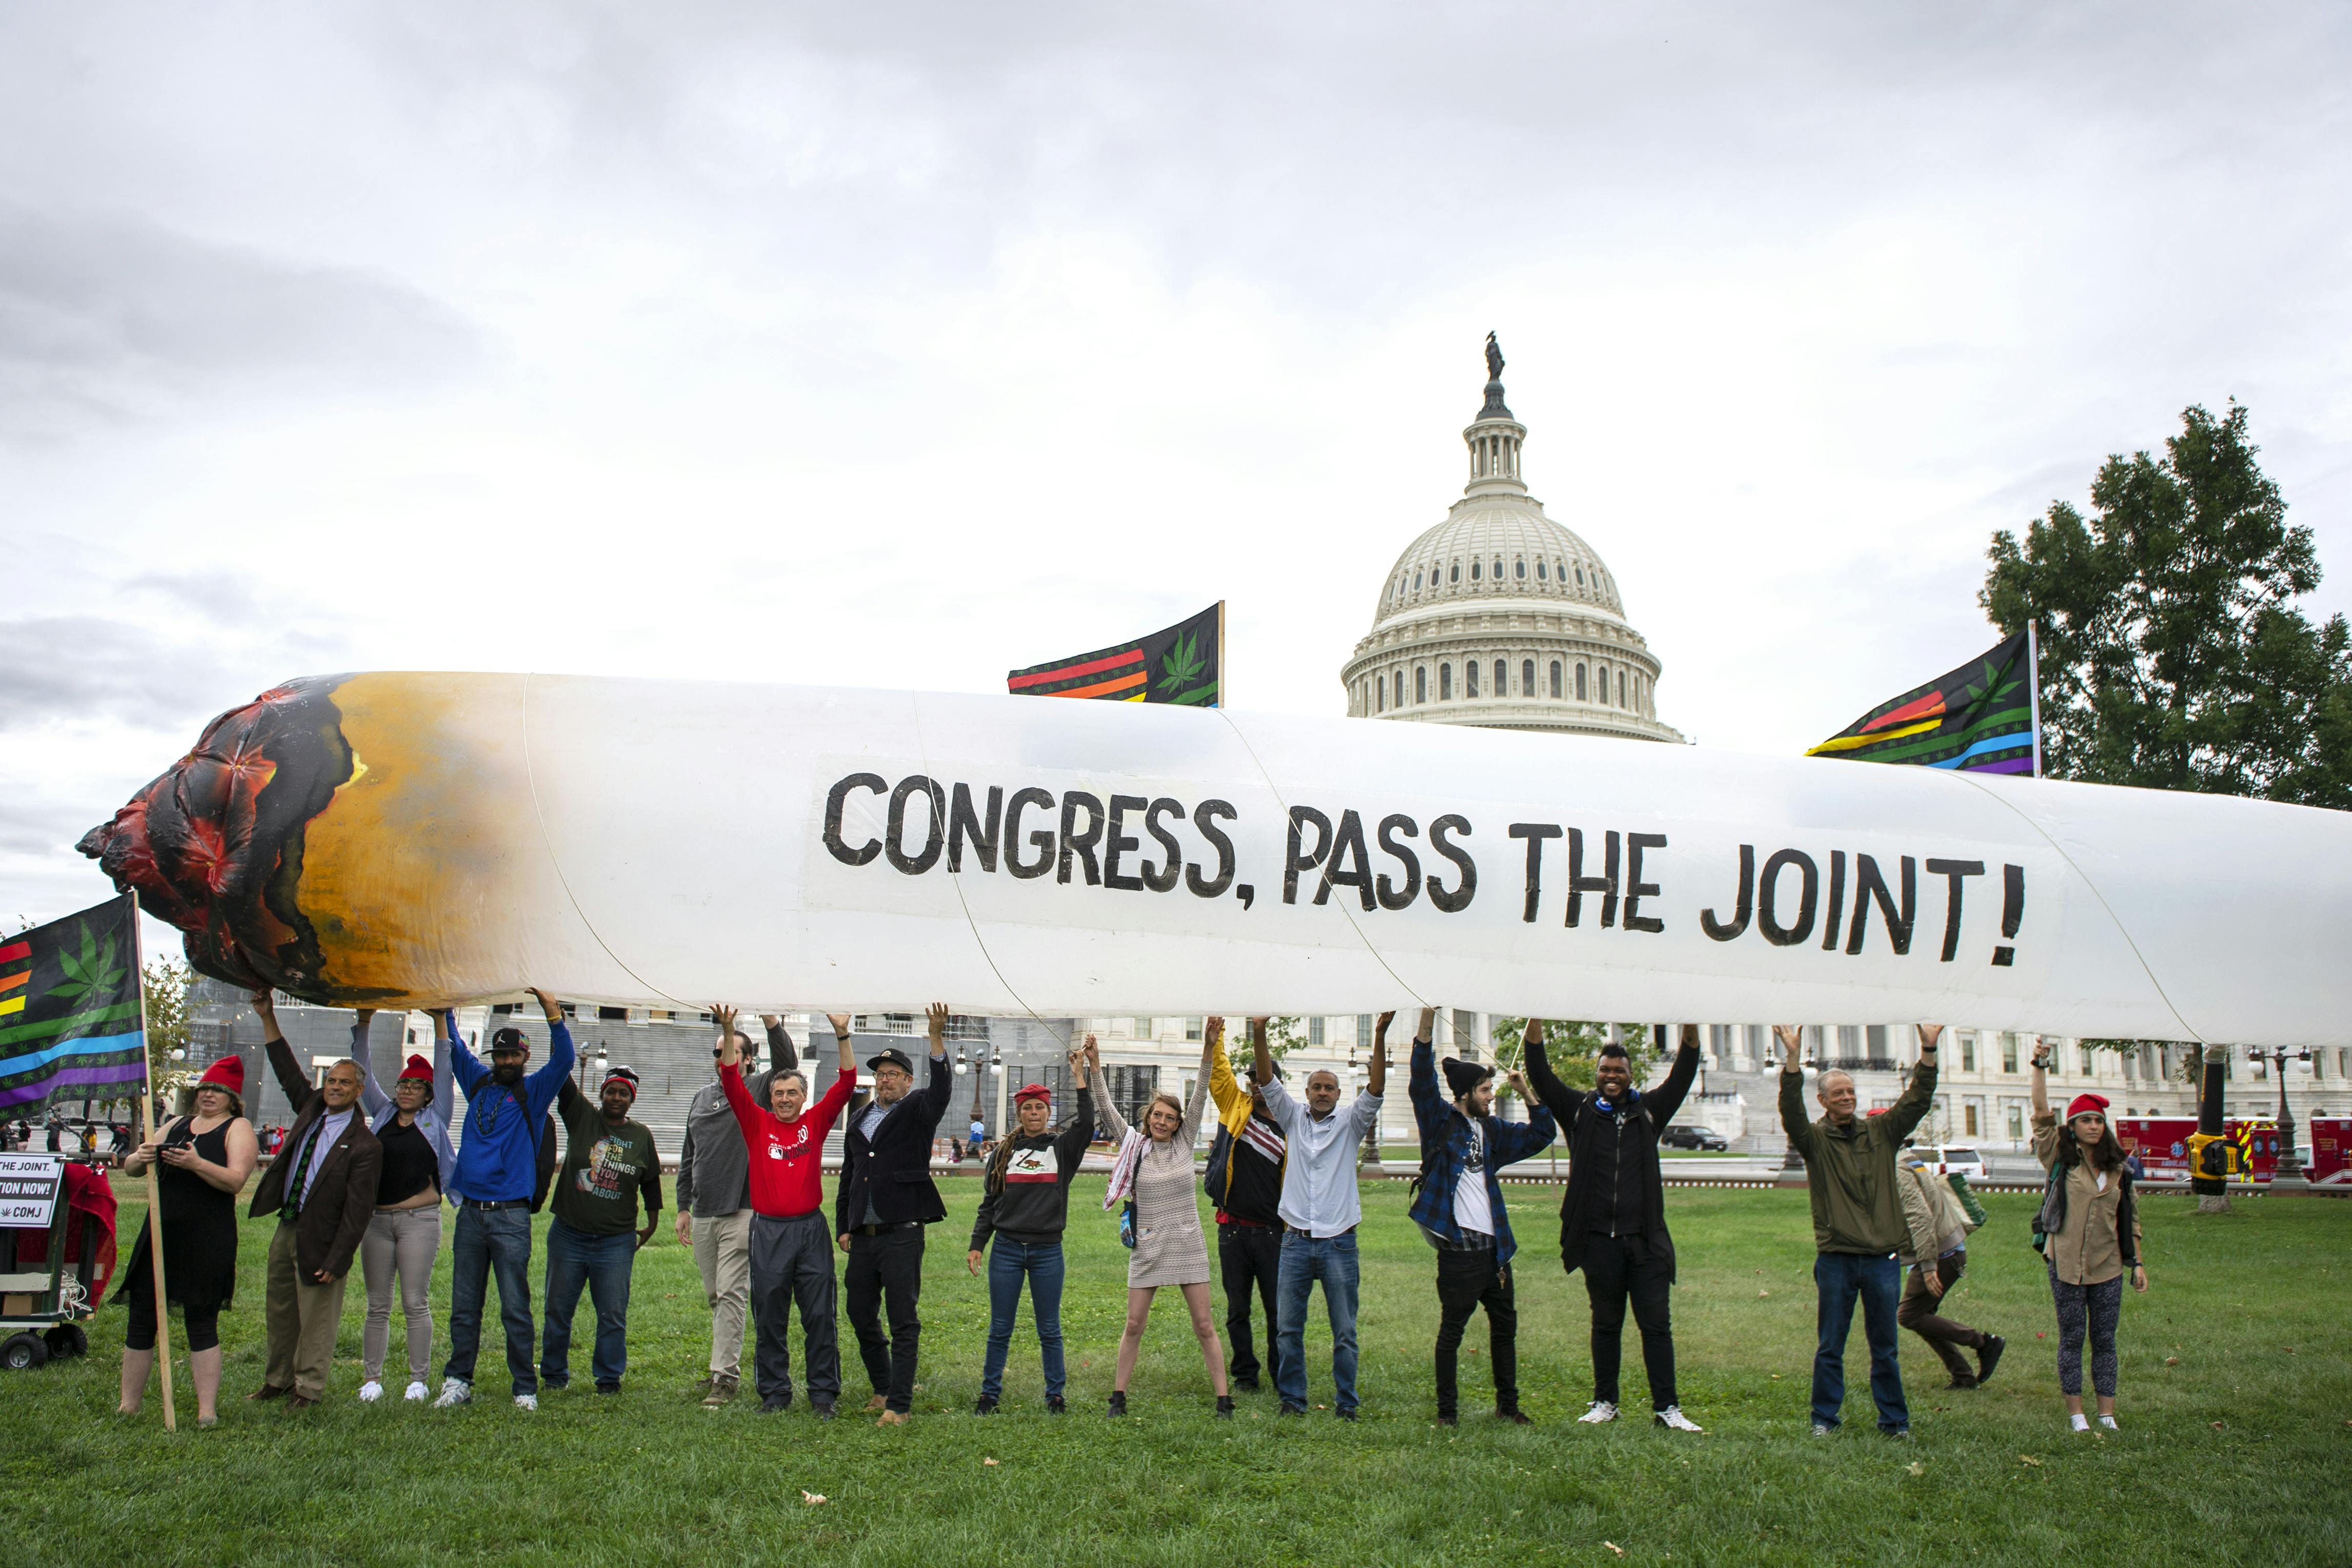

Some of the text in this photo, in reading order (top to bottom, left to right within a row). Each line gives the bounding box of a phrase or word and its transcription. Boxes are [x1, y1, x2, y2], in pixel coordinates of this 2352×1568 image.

[823, 773, 2024, 966] CONGRESS, PASS THE JOINT!
[610, 1135, 633, 1148] FIGHT
[608, 1144, 623, 1154] FOR
[606, 1152, 623, 1162] THE
[17, 1162, 50, 1171] JOINT.
[603, 1159, 636, 1175] THINGS
[600, 1167, 619, 1180] YOU
[22, 1182, 51, 1195] NOW!
[595, 1177, 620, 1190] CARE
[592, 1186, 622, 1200] ABOUT
[13, 1206, 42, 1218] COMJ
